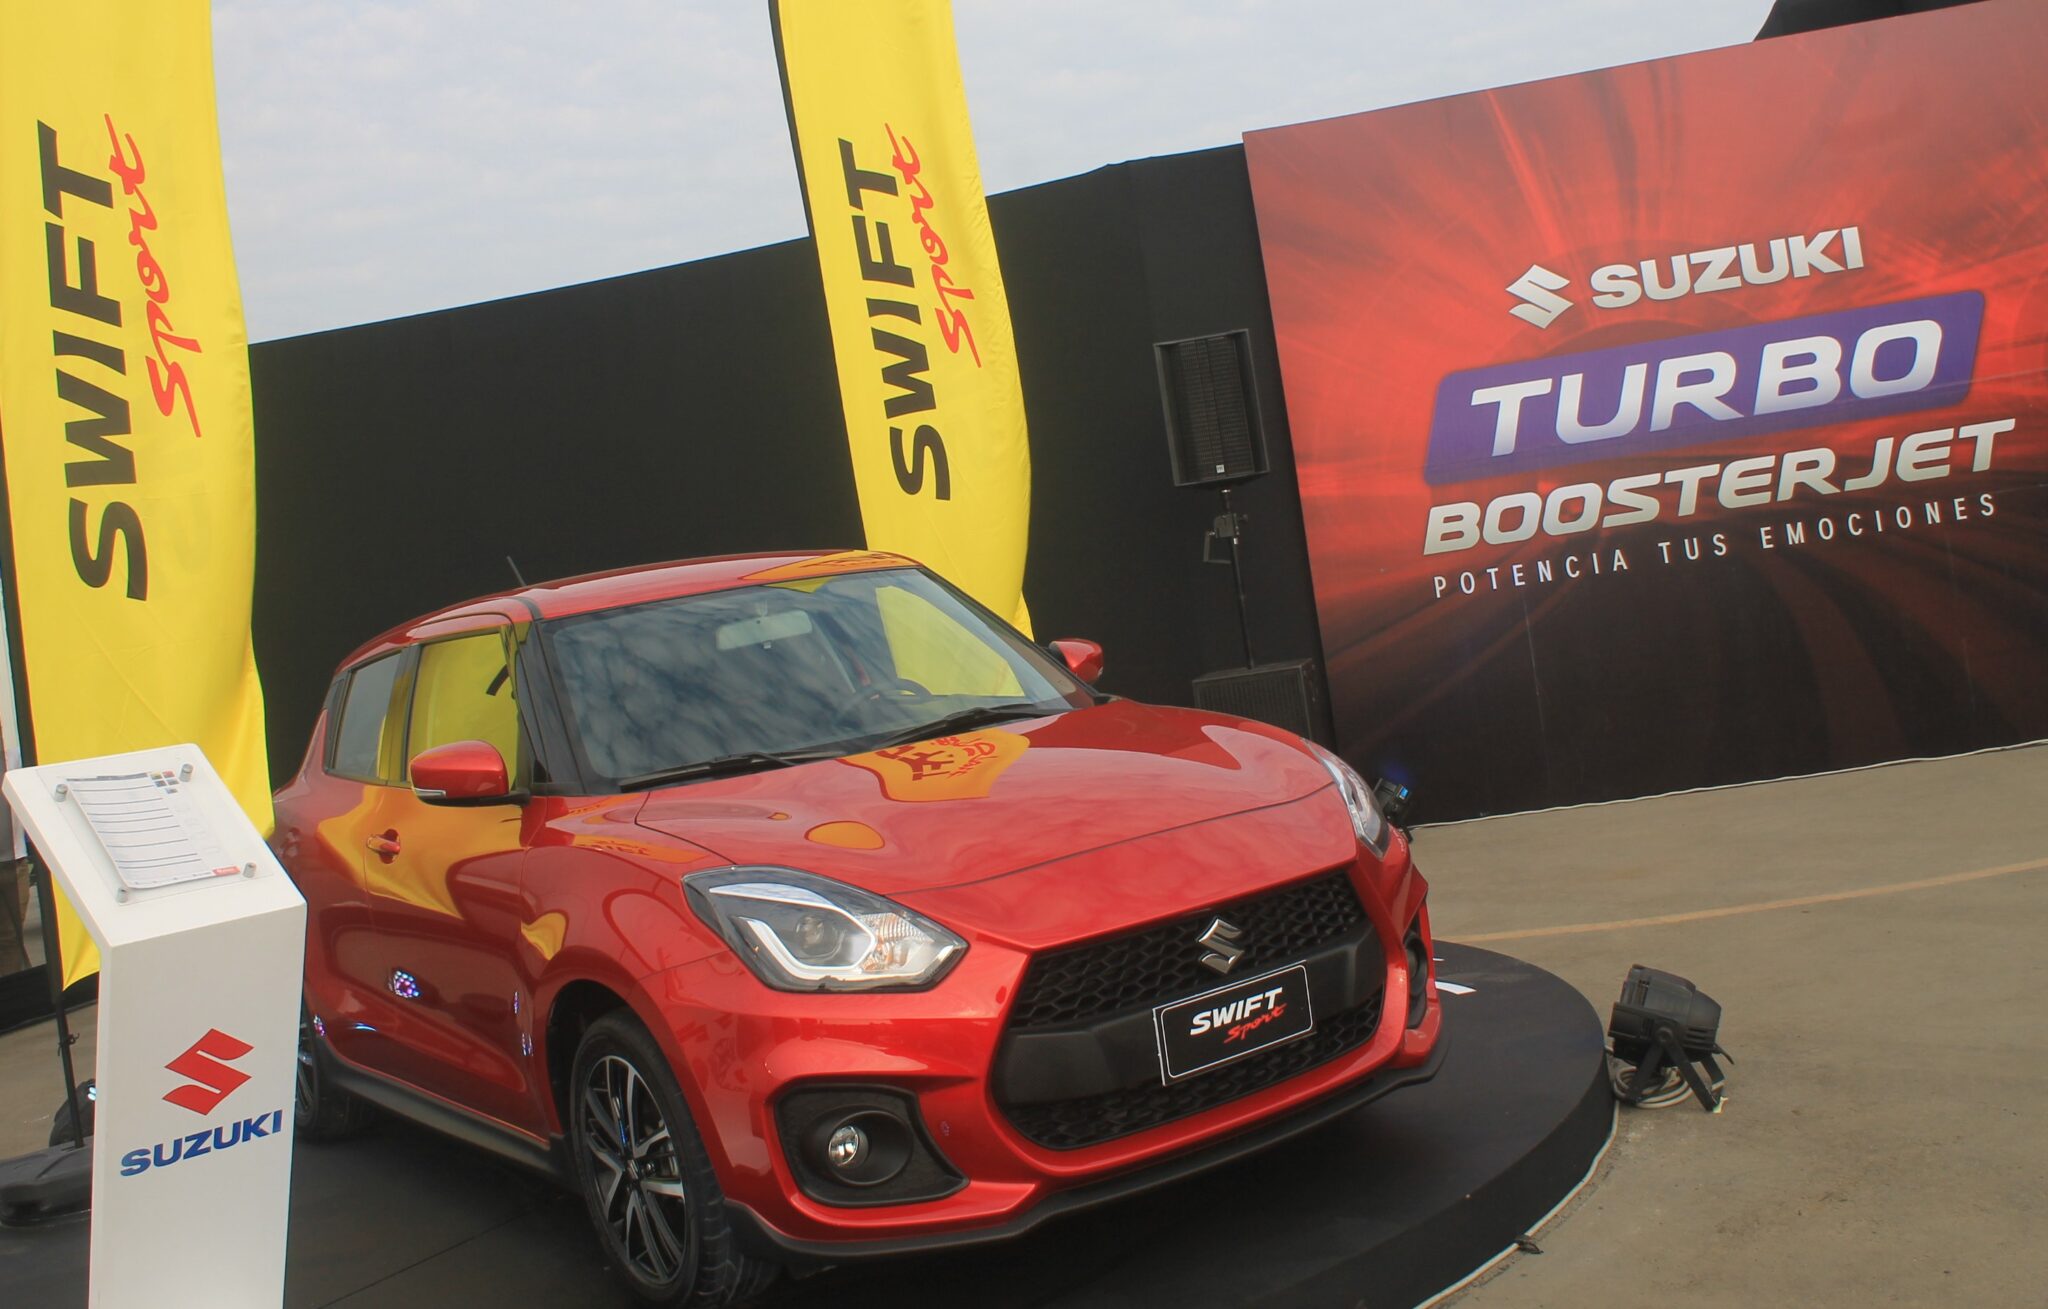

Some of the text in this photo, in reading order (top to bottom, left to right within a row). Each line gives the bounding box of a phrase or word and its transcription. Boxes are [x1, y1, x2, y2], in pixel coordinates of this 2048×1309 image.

[104, 113, 203, 438] Sport
[885, 123, 981, 368] Sport
[1590, 226, 1864, 309] SUZUKI
[37, 120, 147, 601] SWIFT
[838, 138, 950, 501] SWIFT
[1470, 319, 1942, 458] TURBO
[1423, 418, 2016, 556] BOOSTERJET
[1433, 493, 1995, 599] POTENCIA TUS EMOCIONES
[1190, 987, 1282, 1035] SWIFT
[1224, 1002, 1287, 1043] Sport
[120, 1109, 283, 1177] SUZUKI
